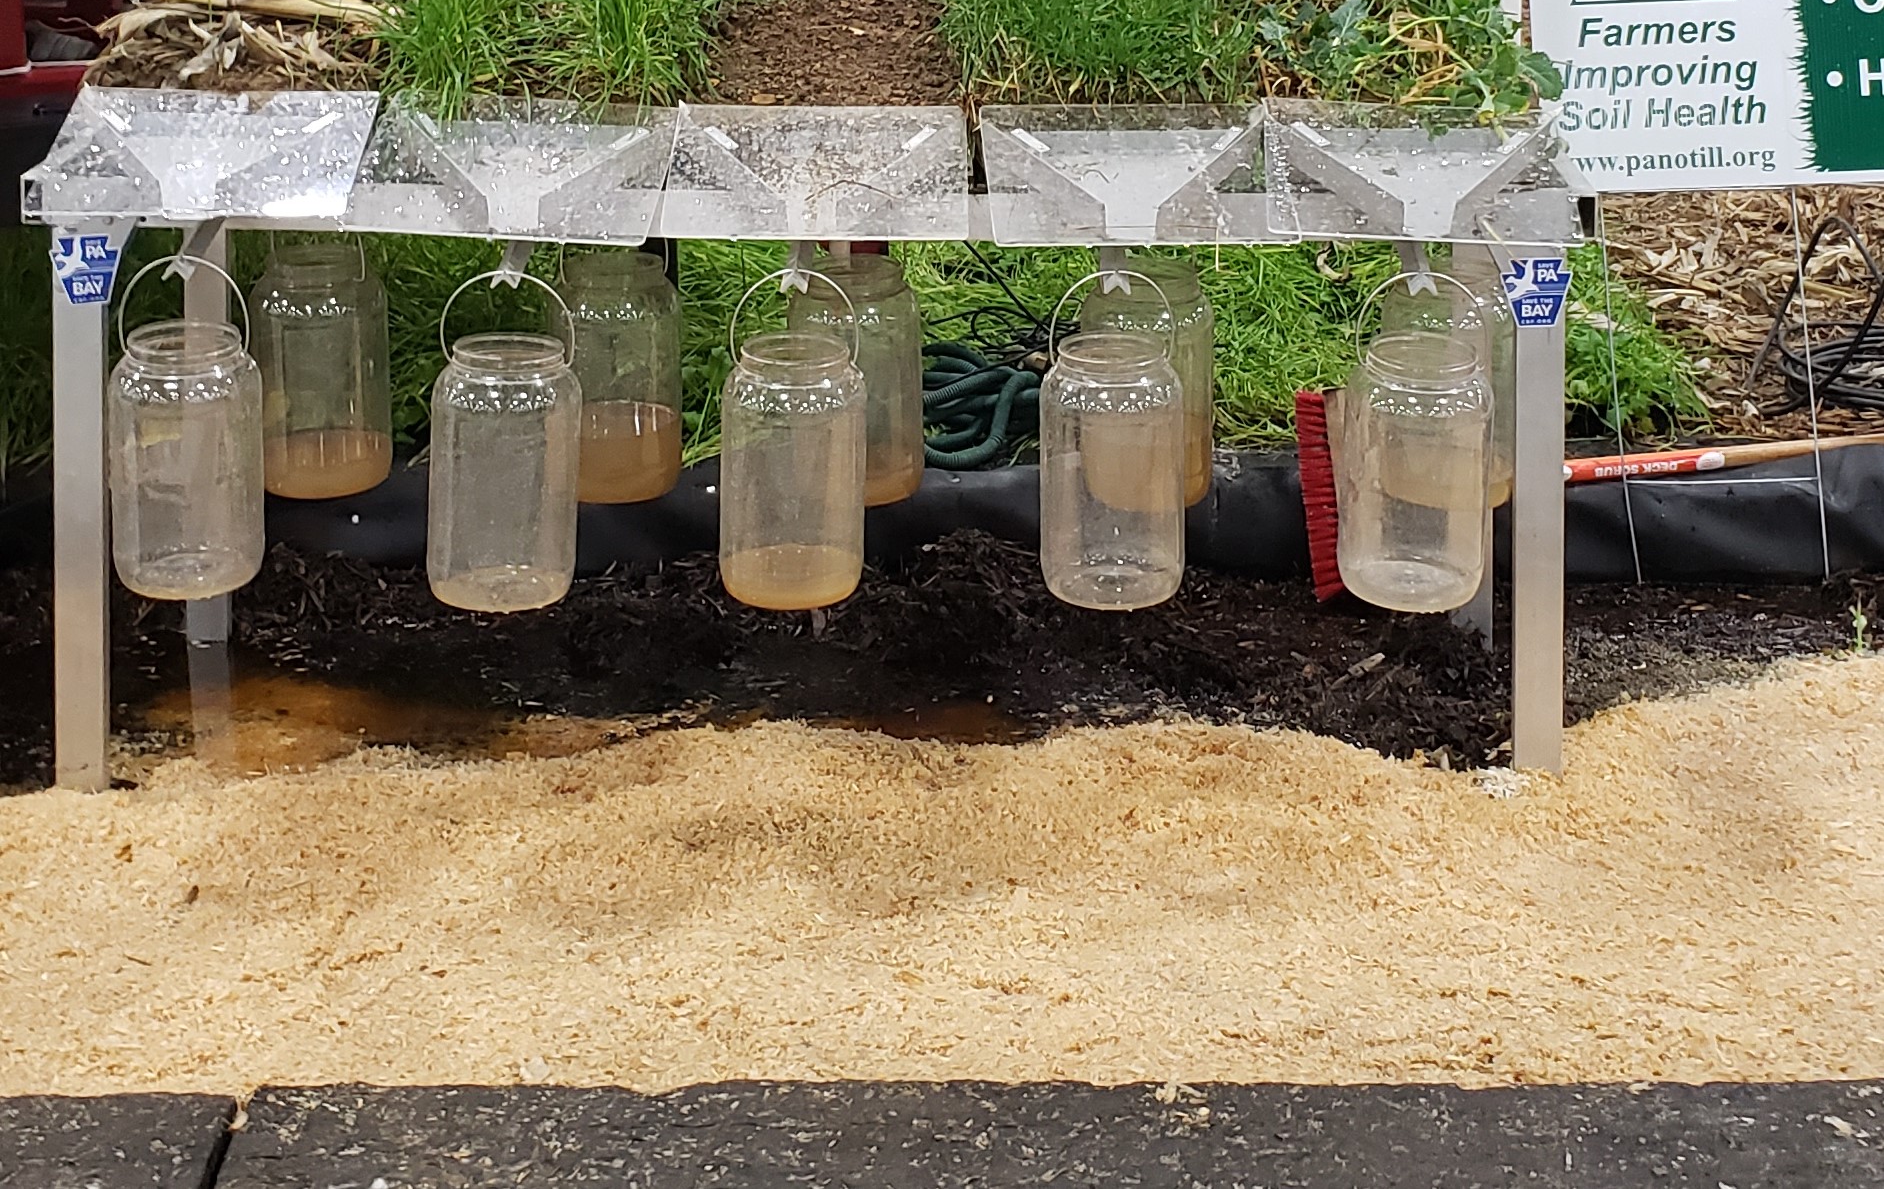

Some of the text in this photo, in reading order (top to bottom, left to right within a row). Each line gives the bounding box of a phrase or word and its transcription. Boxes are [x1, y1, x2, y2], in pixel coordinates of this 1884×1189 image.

[1577, 17, 1737, 48] Farmers
[1563, 55, 1757, 96] Improving
[1558, 94, 1767, 131] Soil Health
[85, 245, 106, 259] PA
[1537, 269, 1558, 282] PA
[72, 280, 104, 296] BAY
[1521, 304, 1553, 317] BAY
[1594, 461, 1679, 477] DECK SCRUB
